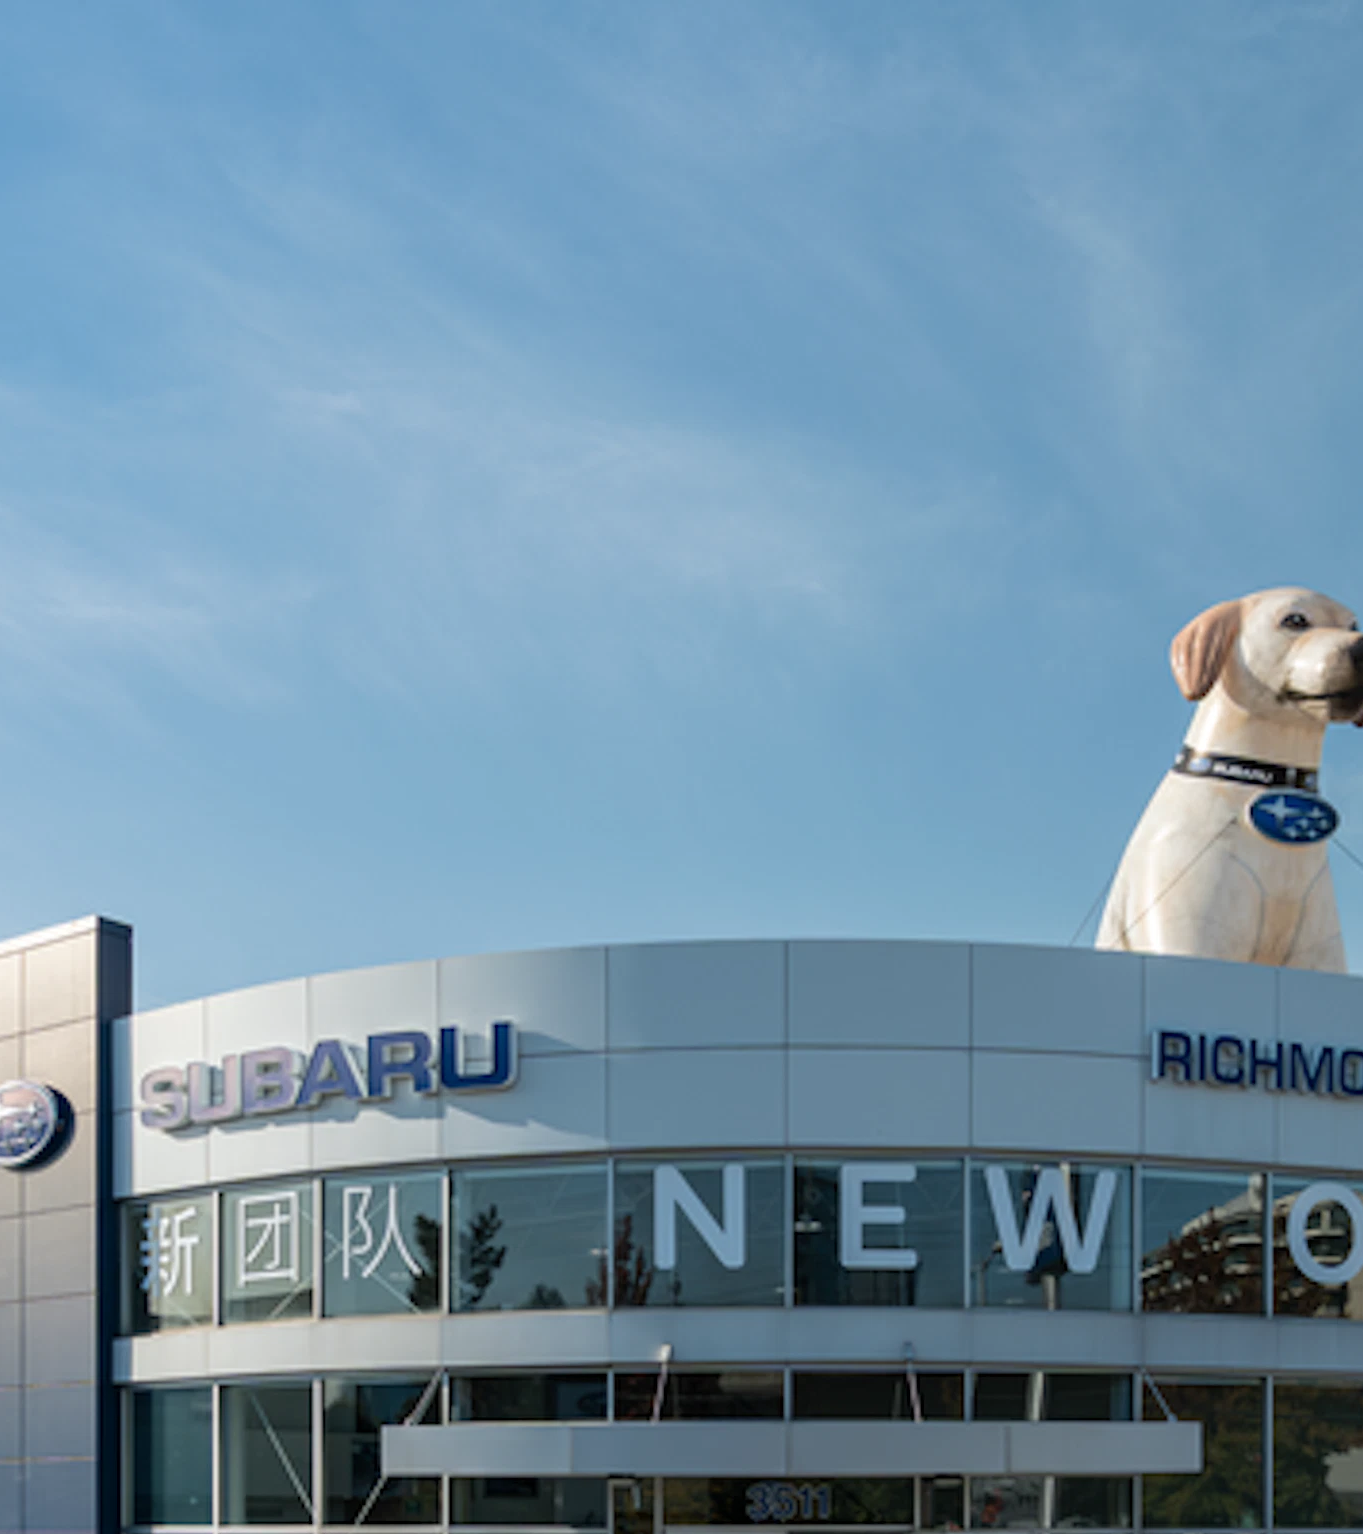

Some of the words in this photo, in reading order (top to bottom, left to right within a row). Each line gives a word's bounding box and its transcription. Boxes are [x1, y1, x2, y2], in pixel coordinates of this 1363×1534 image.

[141, 1020, 516, 1131] SUBARU
[141, 1183, 424, 1298] 新团队
[653, 1163, 1117, 1273] NEW
